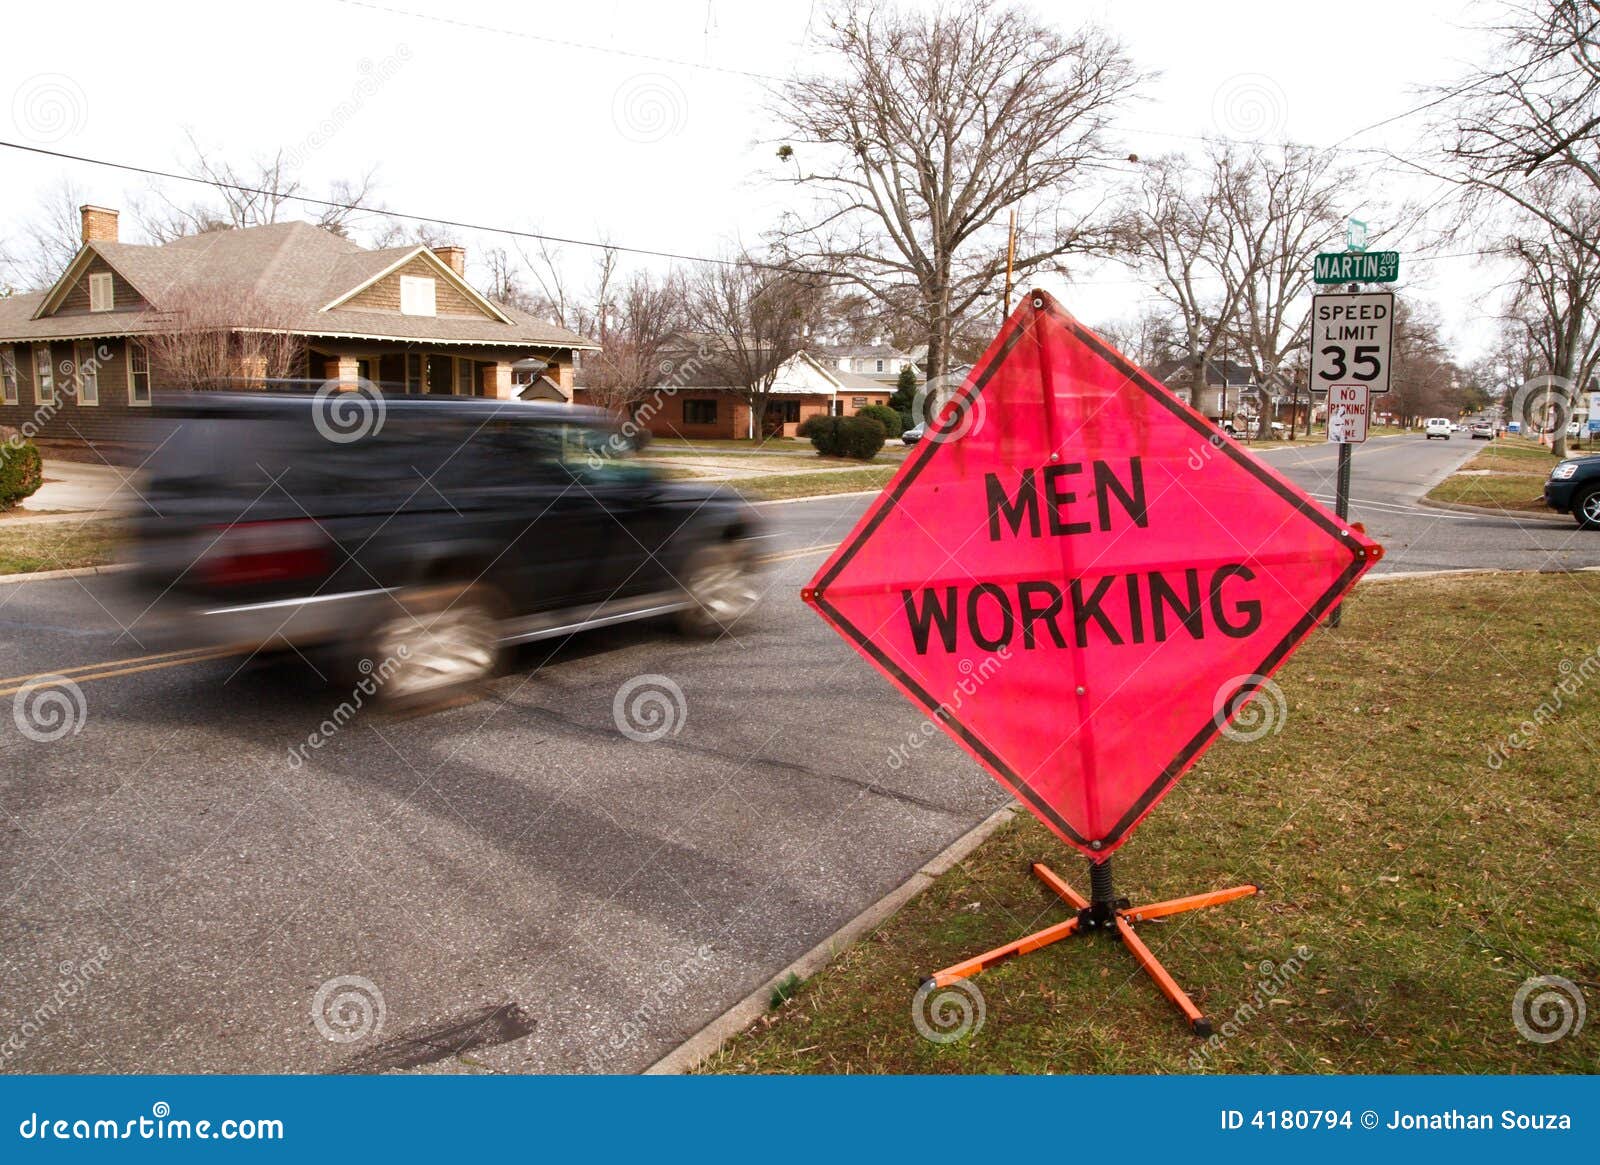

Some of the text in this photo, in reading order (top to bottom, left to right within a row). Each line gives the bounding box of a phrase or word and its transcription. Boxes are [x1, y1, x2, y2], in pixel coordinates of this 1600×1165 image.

[1316, 256, 1396, 279] MARTIN ST
[1380, 253, 1396, 265] 200
[1319, 305, 1387, 320] SPEED
[1326, 326, 1378, 340] LIMIT
[1318, 345, 1381, 381] 35
[1340, 390, 1356, 400] NO
[984, 455, 1149, 542] MEN
[901, 563, 1263, 655] WORKING
